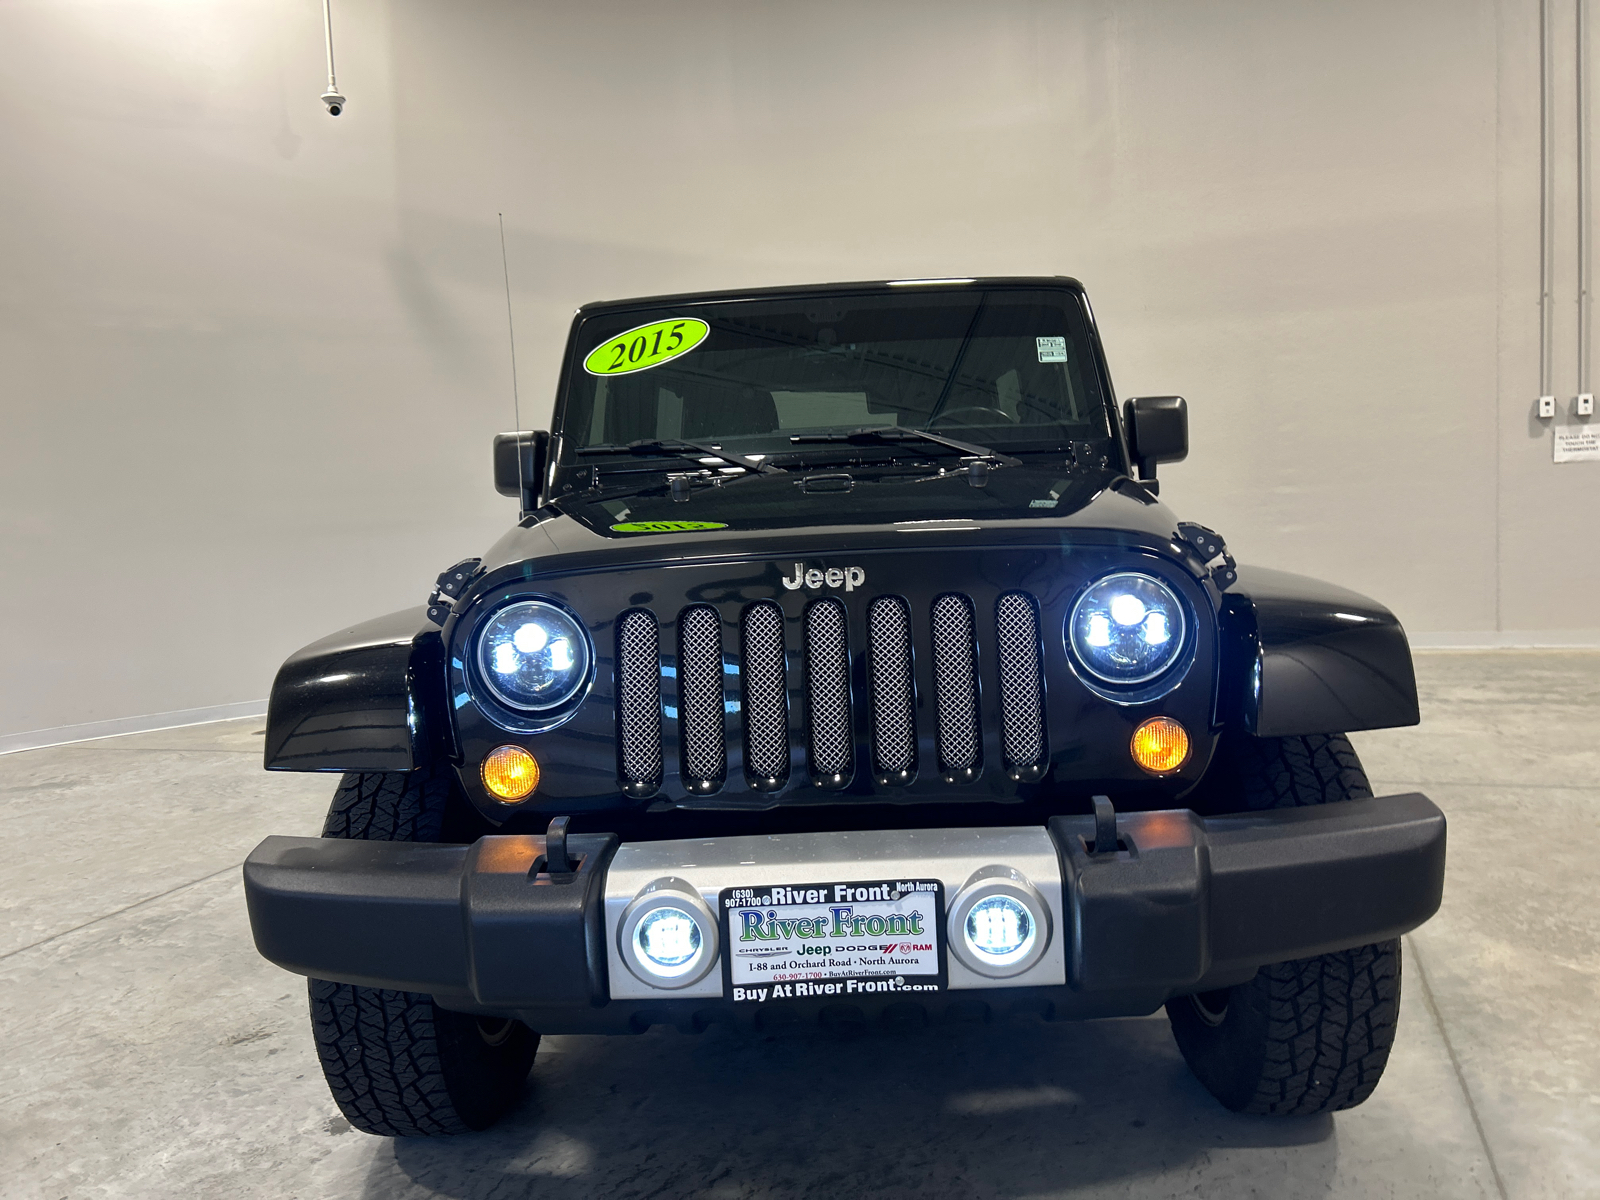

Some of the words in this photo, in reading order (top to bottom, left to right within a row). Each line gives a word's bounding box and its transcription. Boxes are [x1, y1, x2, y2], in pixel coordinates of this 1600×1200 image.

[607, 322, 686, 371] 2015
[782, 562, 866, 592] Jeep
[732, 889, 754, 899] (630)
[896, 881, 915, 892] North
[915, 881, 938, 891] Aurora
[725, 897, 761, 907] 907-1700
[771, 886, 828, 905] River
[834, 884, 890, 902] Front
[738, 909, 829, 942] River
[829, 905, 925, 938] Front
[796, 944, 832, 956] Jeep
[835, 945, 888, 953] DODGE
[749, 962, 768, 971] I-88
[770, 961, 787, 970] and
[789, 958, 826, 969] Orchard
[828, 957, 852, 967] Road
[859, 957, 886, 965] North
[888, 956, 920, 965] Aurora
[772, 971, 823, 981] 630-907-1700
[828, 969, 897, 977] BuyAtRiverFront.com
[733, 988, 768, 1002] Buy
[772, 984, 792, 998] At
[795, 982, 843, 996] River
